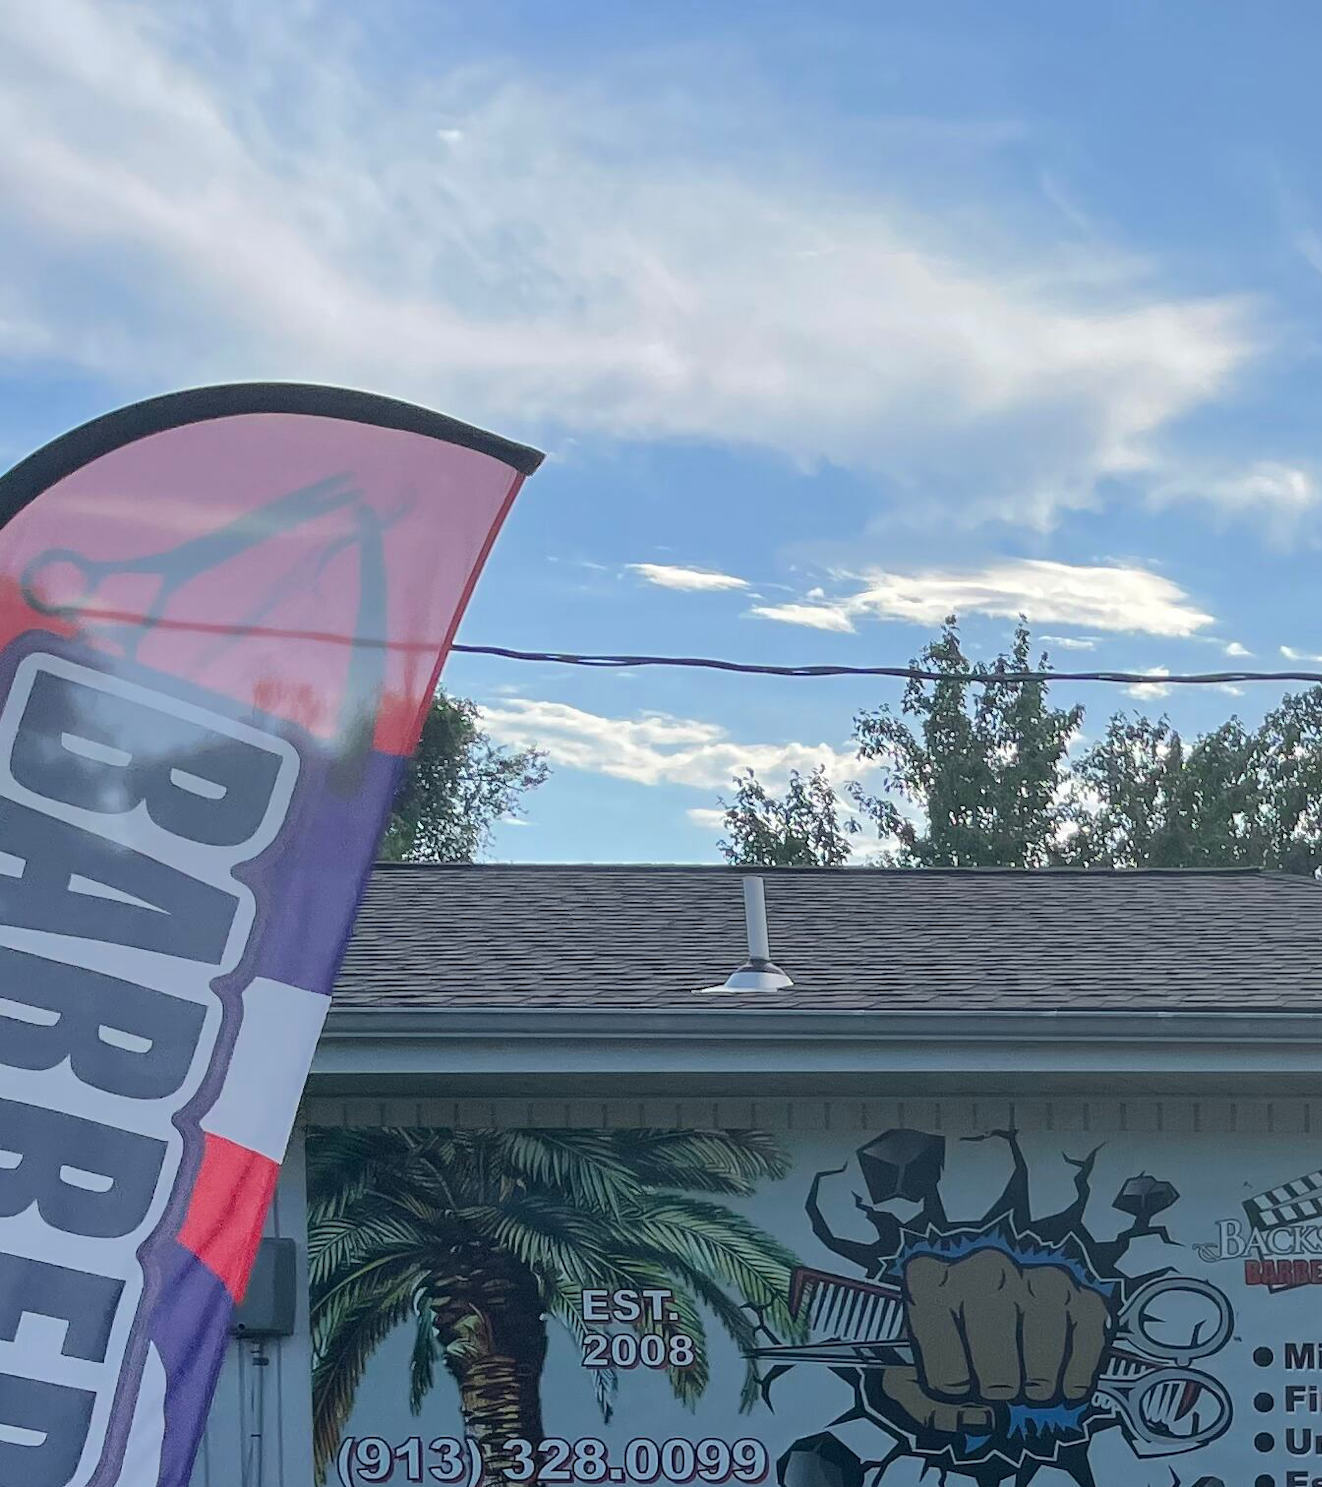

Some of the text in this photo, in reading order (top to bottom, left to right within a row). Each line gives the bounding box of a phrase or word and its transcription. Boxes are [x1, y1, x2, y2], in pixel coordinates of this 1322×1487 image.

[581, 1289, 679, 1323] EST.
[582, 1333, 696, 1369] 2008
[502, 1437, 769, 1485] 328.0099
